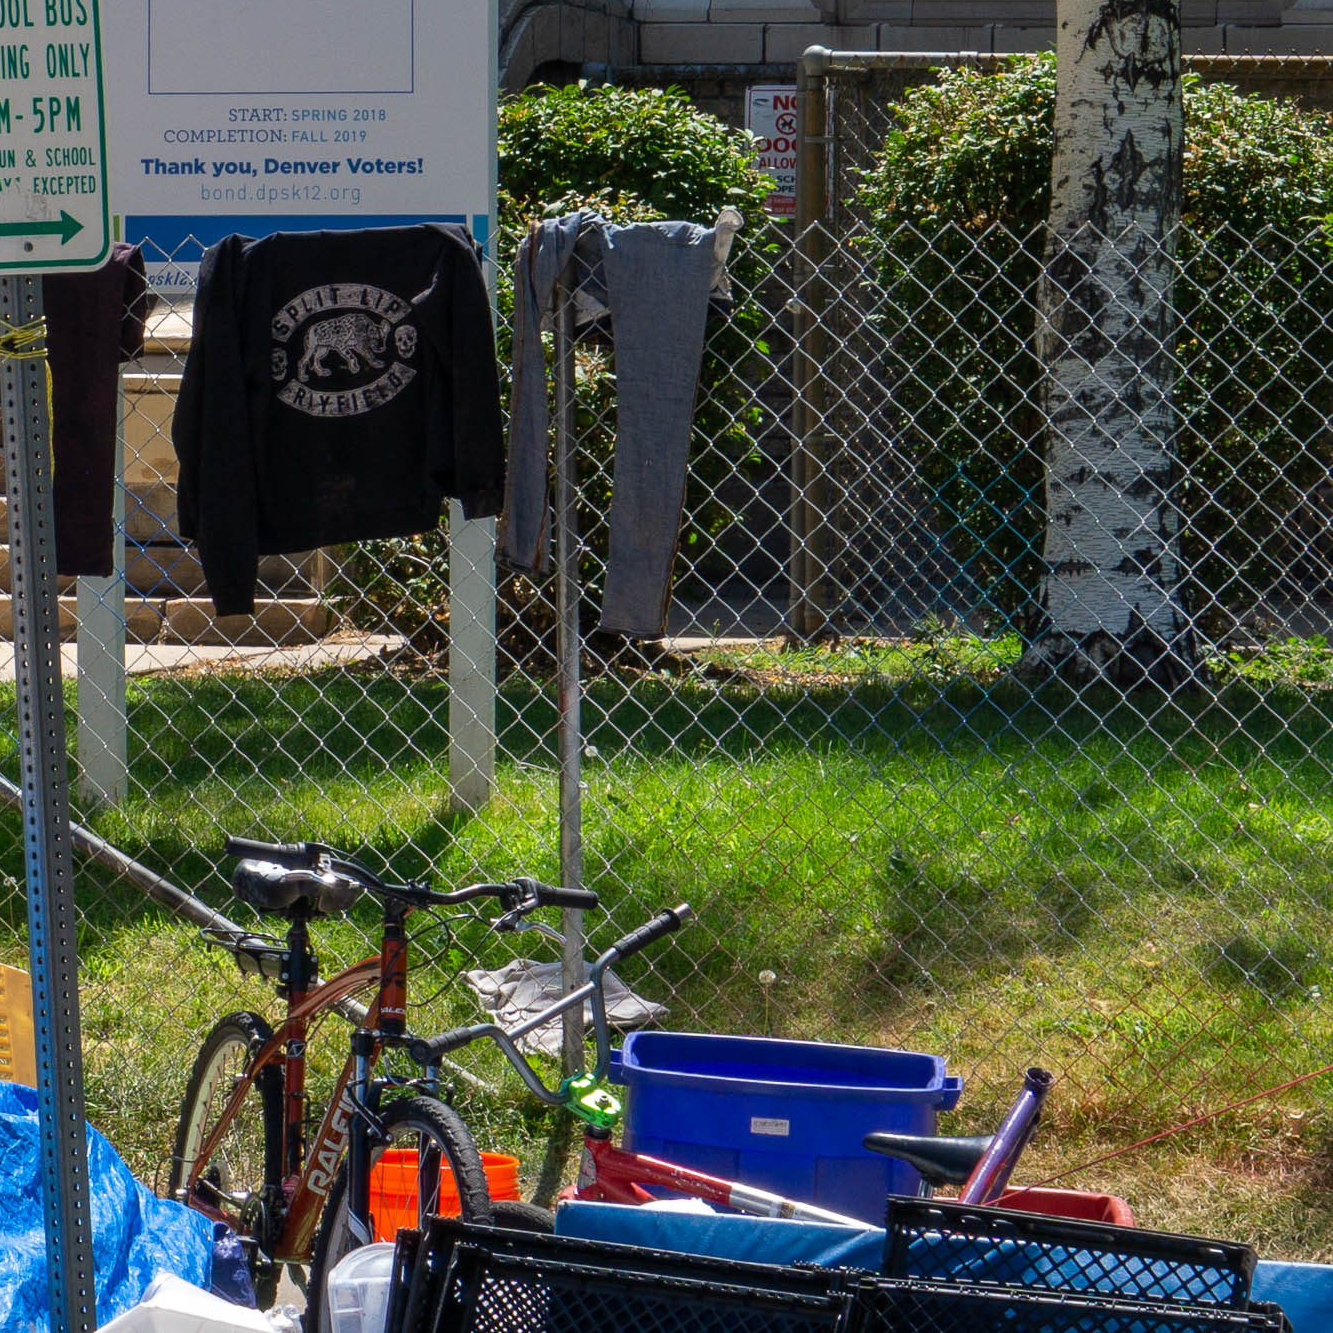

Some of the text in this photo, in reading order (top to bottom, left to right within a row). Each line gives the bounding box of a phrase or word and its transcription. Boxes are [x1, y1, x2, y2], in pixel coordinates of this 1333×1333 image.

[46, 43, 90, 79] ONLY
[228, 108, 387, 122] START: SPRING 2018
[163, 129, 367, 143] COMPLETION: FALL 2019
[25, 149, 37, 167] &
[46, 147, 97, 167] SCHOOL
[141, 157, 424, 178] Thank you, Denver Voters!
[33, 175, 97, 196] EXCEPTED
[201, 183, 361, 204] bond.dpsk12.org
[273, 287, 402, 336] SPLIT LIP
